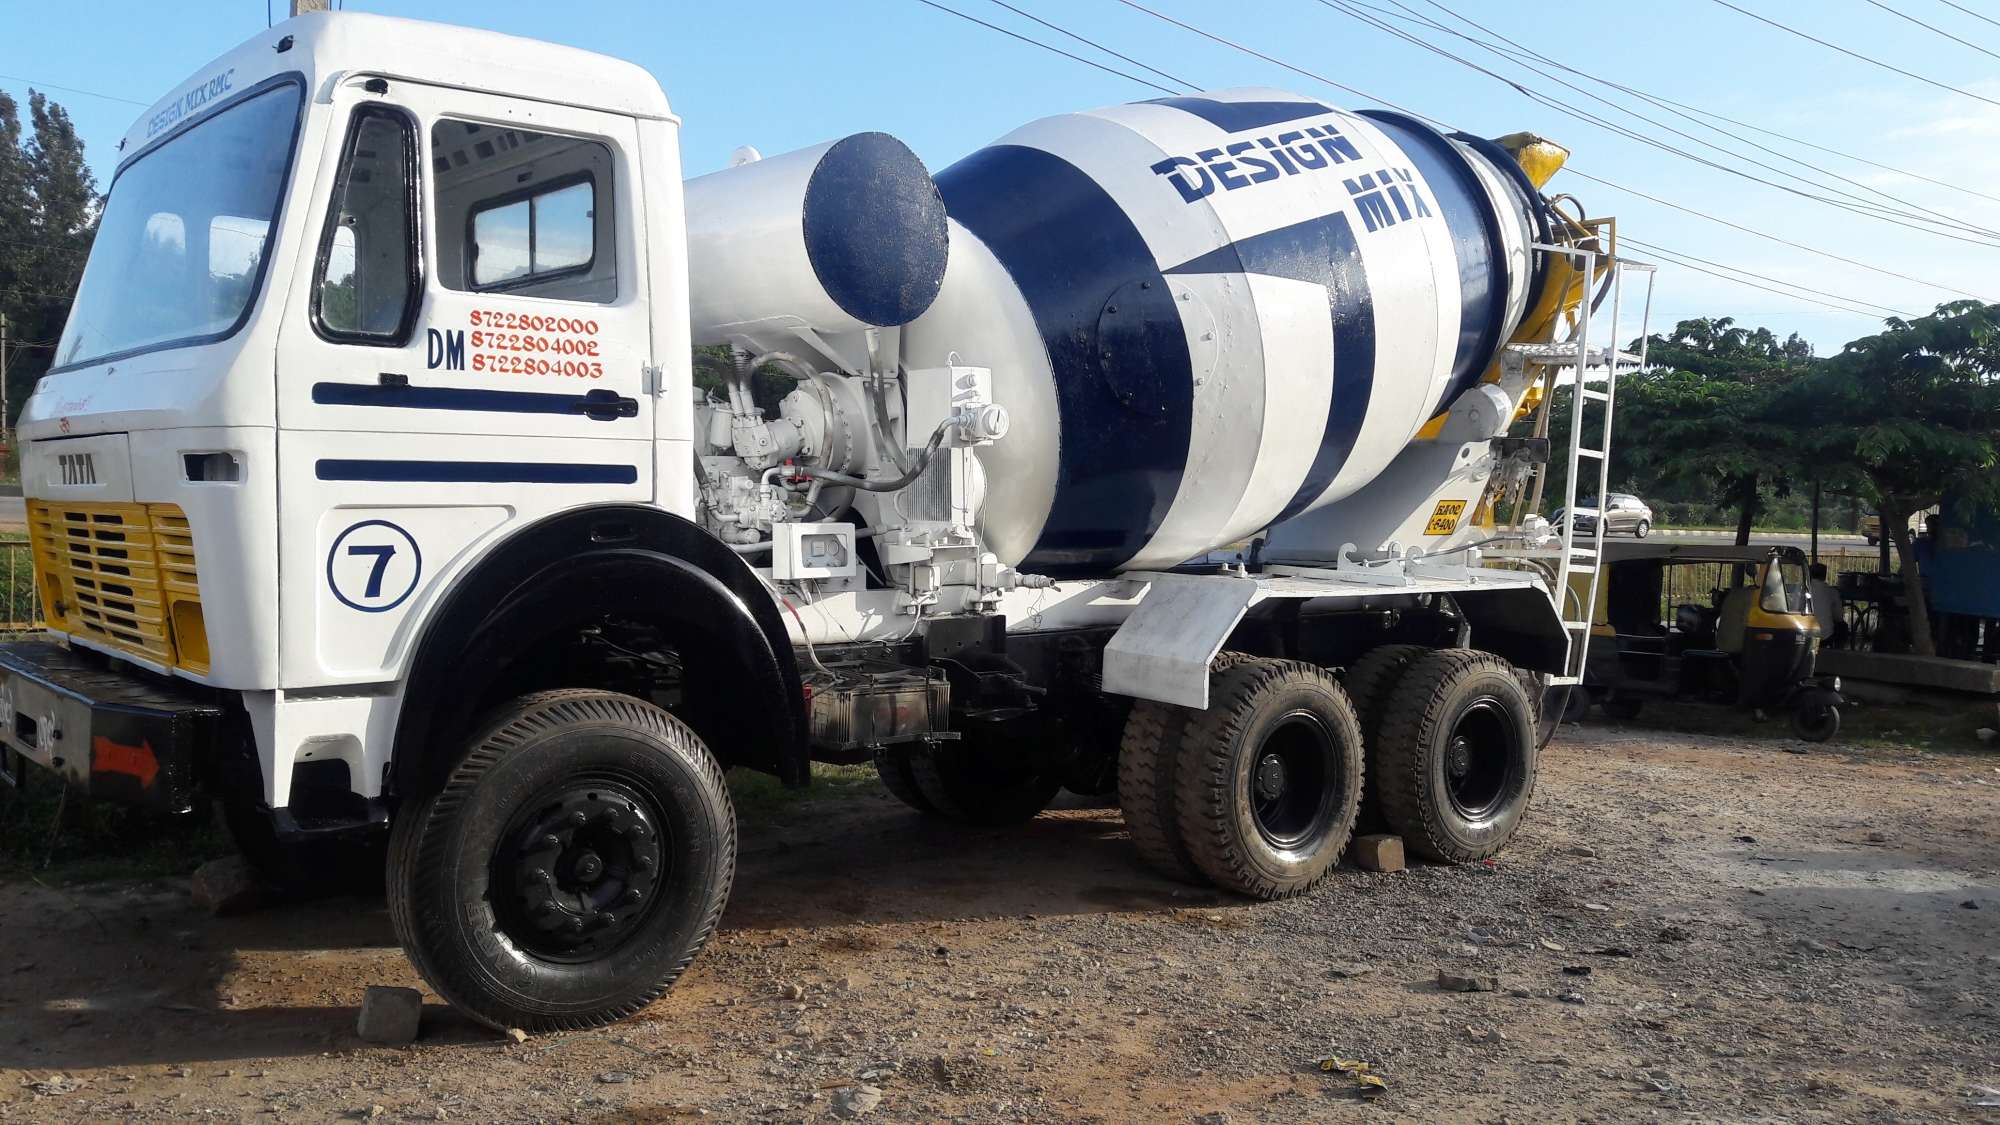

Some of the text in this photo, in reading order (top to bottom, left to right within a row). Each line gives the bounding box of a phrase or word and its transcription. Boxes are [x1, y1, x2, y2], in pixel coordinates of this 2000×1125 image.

[146, 68, 235, 138] DESIGN MIX RMC
[1150, 124, 1363, 204] DESIGN
[1342, 167, 1432, 233] MIX
[470, 310, 599, 335] 8722802000
[471, 331, 600, 356] 8722804002
[427, 328, 465, 371] DM
[472, 354, 603, 379] 8722804003
[58, 453, 97, 485] TATA
[348, 545, 397, 598] 7
